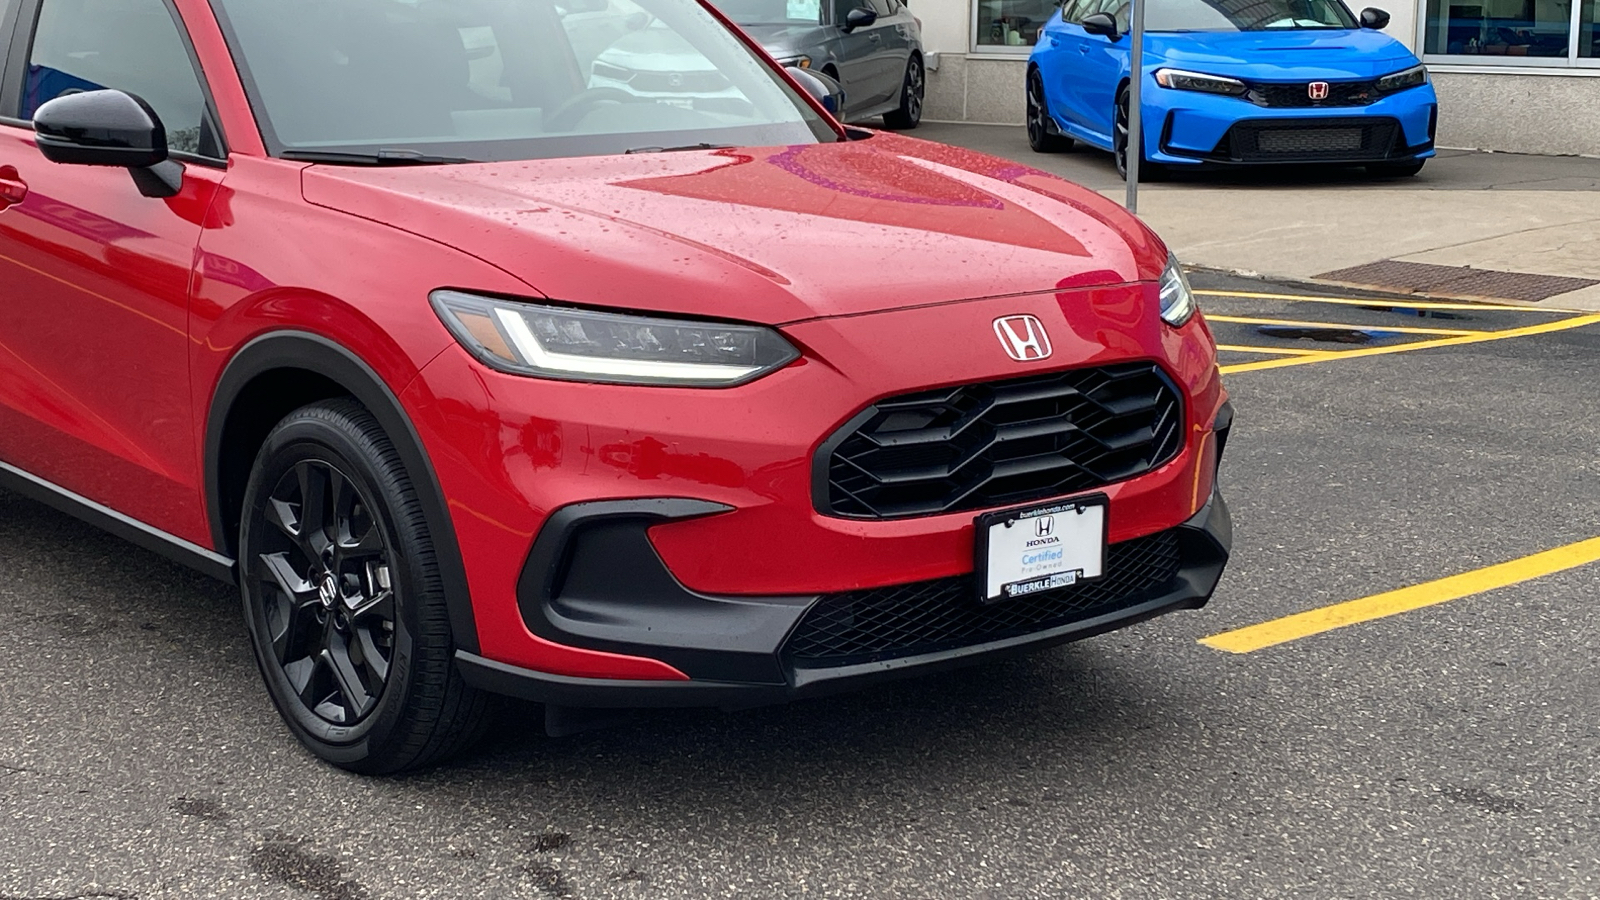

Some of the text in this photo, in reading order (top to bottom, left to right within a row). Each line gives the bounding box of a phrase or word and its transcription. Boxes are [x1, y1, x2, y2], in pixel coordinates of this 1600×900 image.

[1019, 503, 1075, 519] buerklehonda.com
[1026, 536, 1060, 547] HONDA
[1022, 547, 1063, 565] Certified
[1021, 561, 1063, 574] Pre-Owned
[1011, 575, 1074, 595] BUERKLE HONDA
